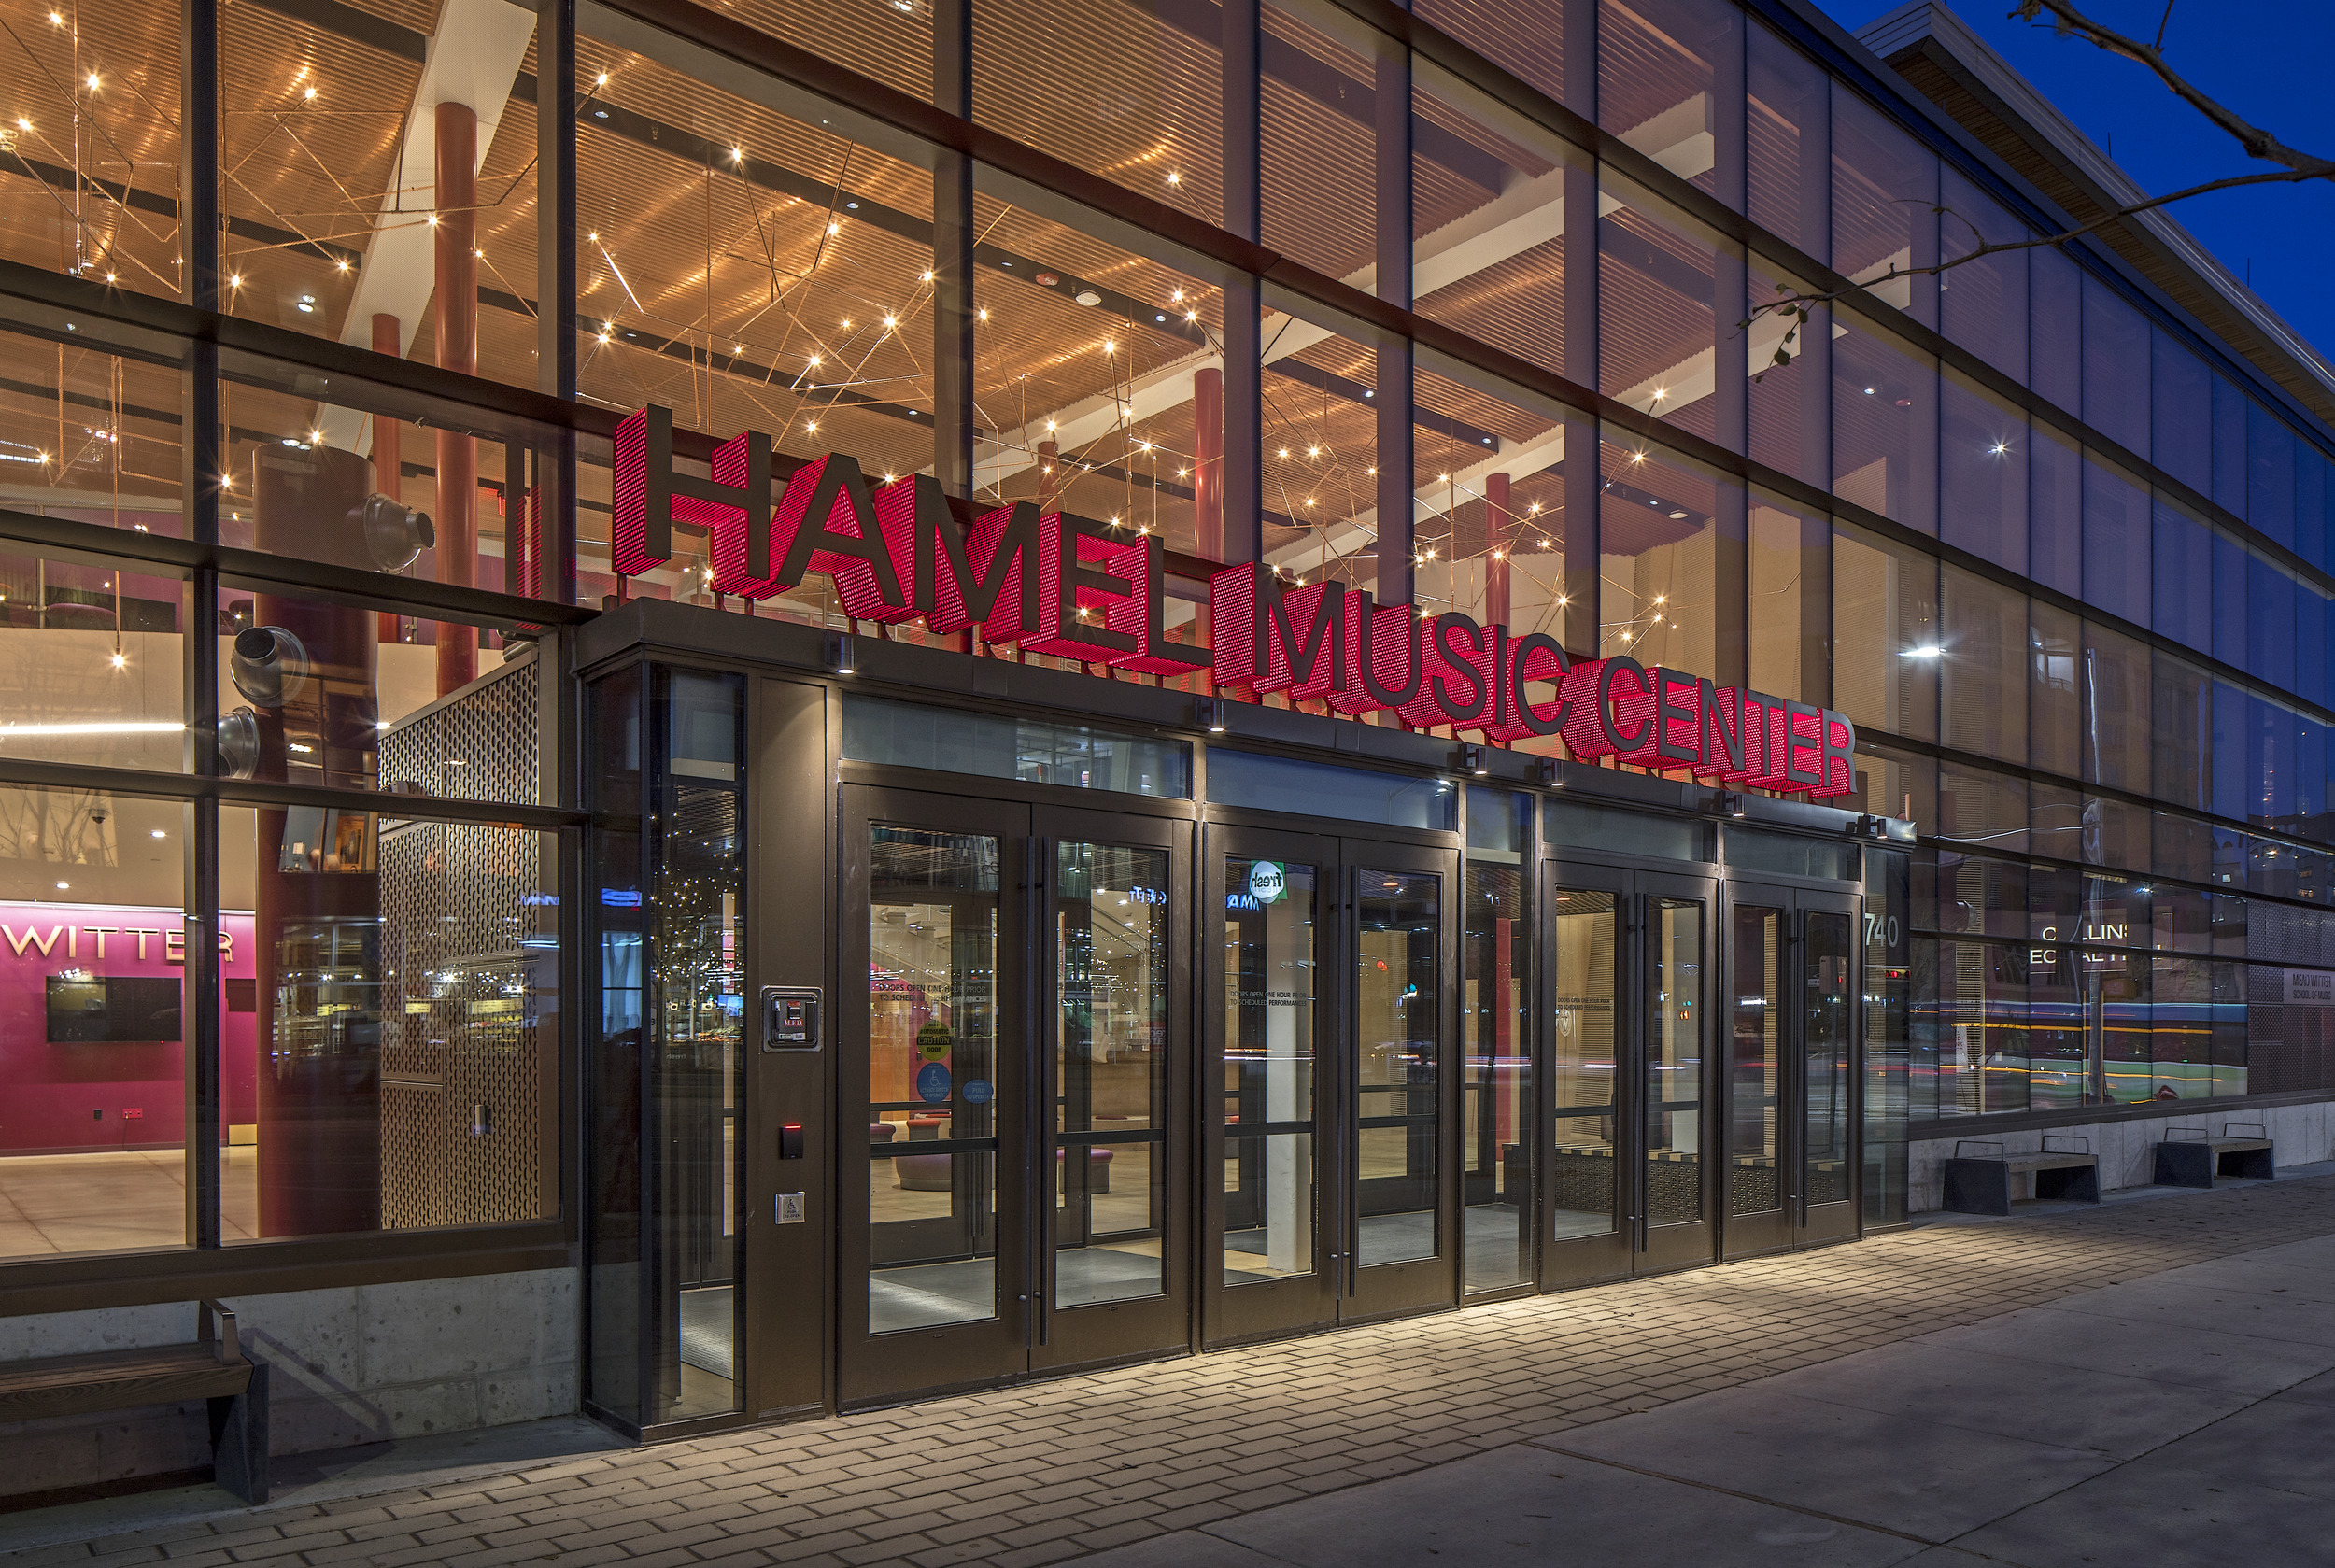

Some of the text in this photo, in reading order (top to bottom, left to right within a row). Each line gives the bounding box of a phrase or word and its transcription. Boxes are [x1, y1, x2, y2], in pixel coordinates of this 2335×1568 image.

[614, 403, 1858, 798] HAMEL MUSIC CENTER
[1, 925, 234, 963] WITTER
[1865, 913, 1898, 947] 740
[879, 983, 904, 992] DOORS
[906, 983, 925, 992] OPEN
[927, 983, 942, 992] ONE
[917, 1036, 951, 1044] CAUTION
